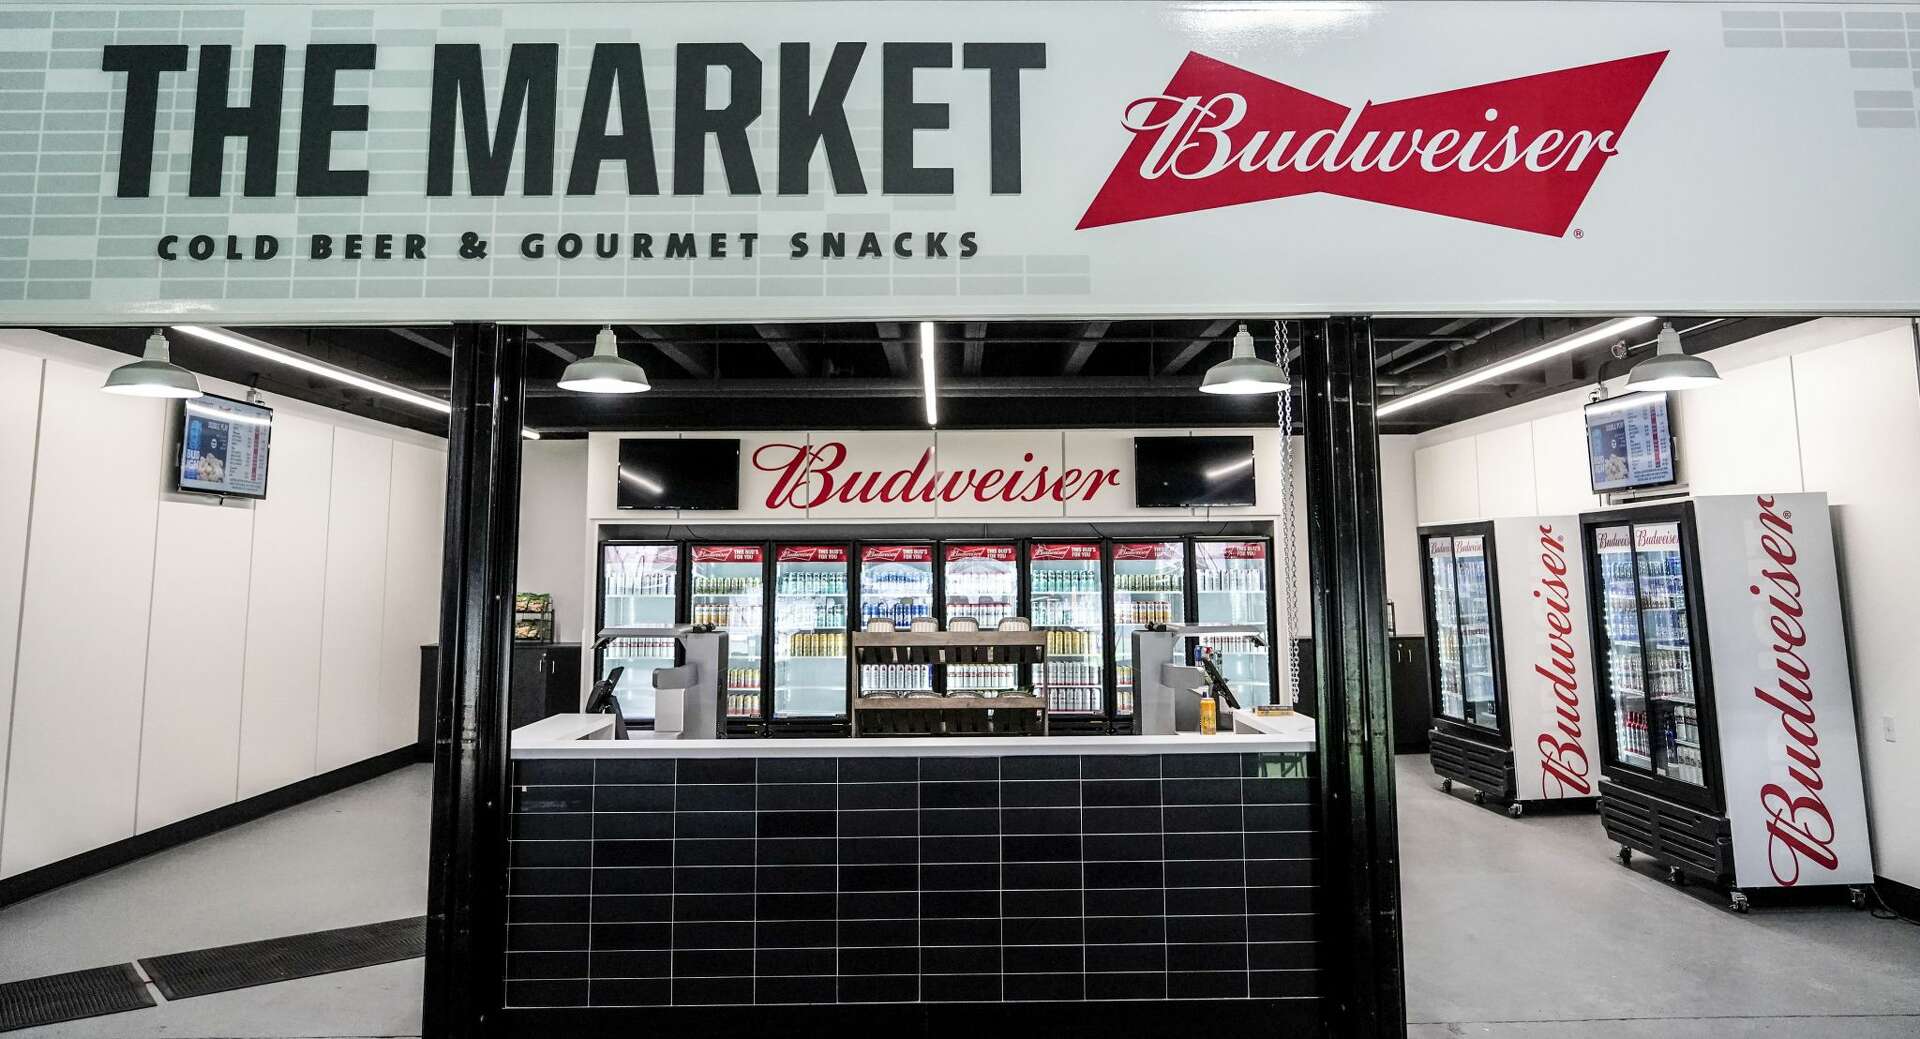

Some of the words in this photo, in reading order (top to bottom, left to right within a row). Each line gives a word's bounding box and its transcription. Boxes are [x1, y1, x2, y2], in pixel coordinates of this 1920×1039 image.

[103, 44, 376, 197] THE
[427, 42, 1046, 196] MARKET
[1120, 93, 1619, 179] Budweiser
[158, 234, 279, 260] COLD
[311, 234, 427, 260] BEER
[459, 232, 488, 259] &
[521, 232, 758, 259] GOURMET
[791, 231, 978, 258] SNACKS
[752, 442, 1119, 510] Budweiser
[1533, 524, 1591, 798] Budweiser
[1750, 495, 1839, 887] Budweiser
